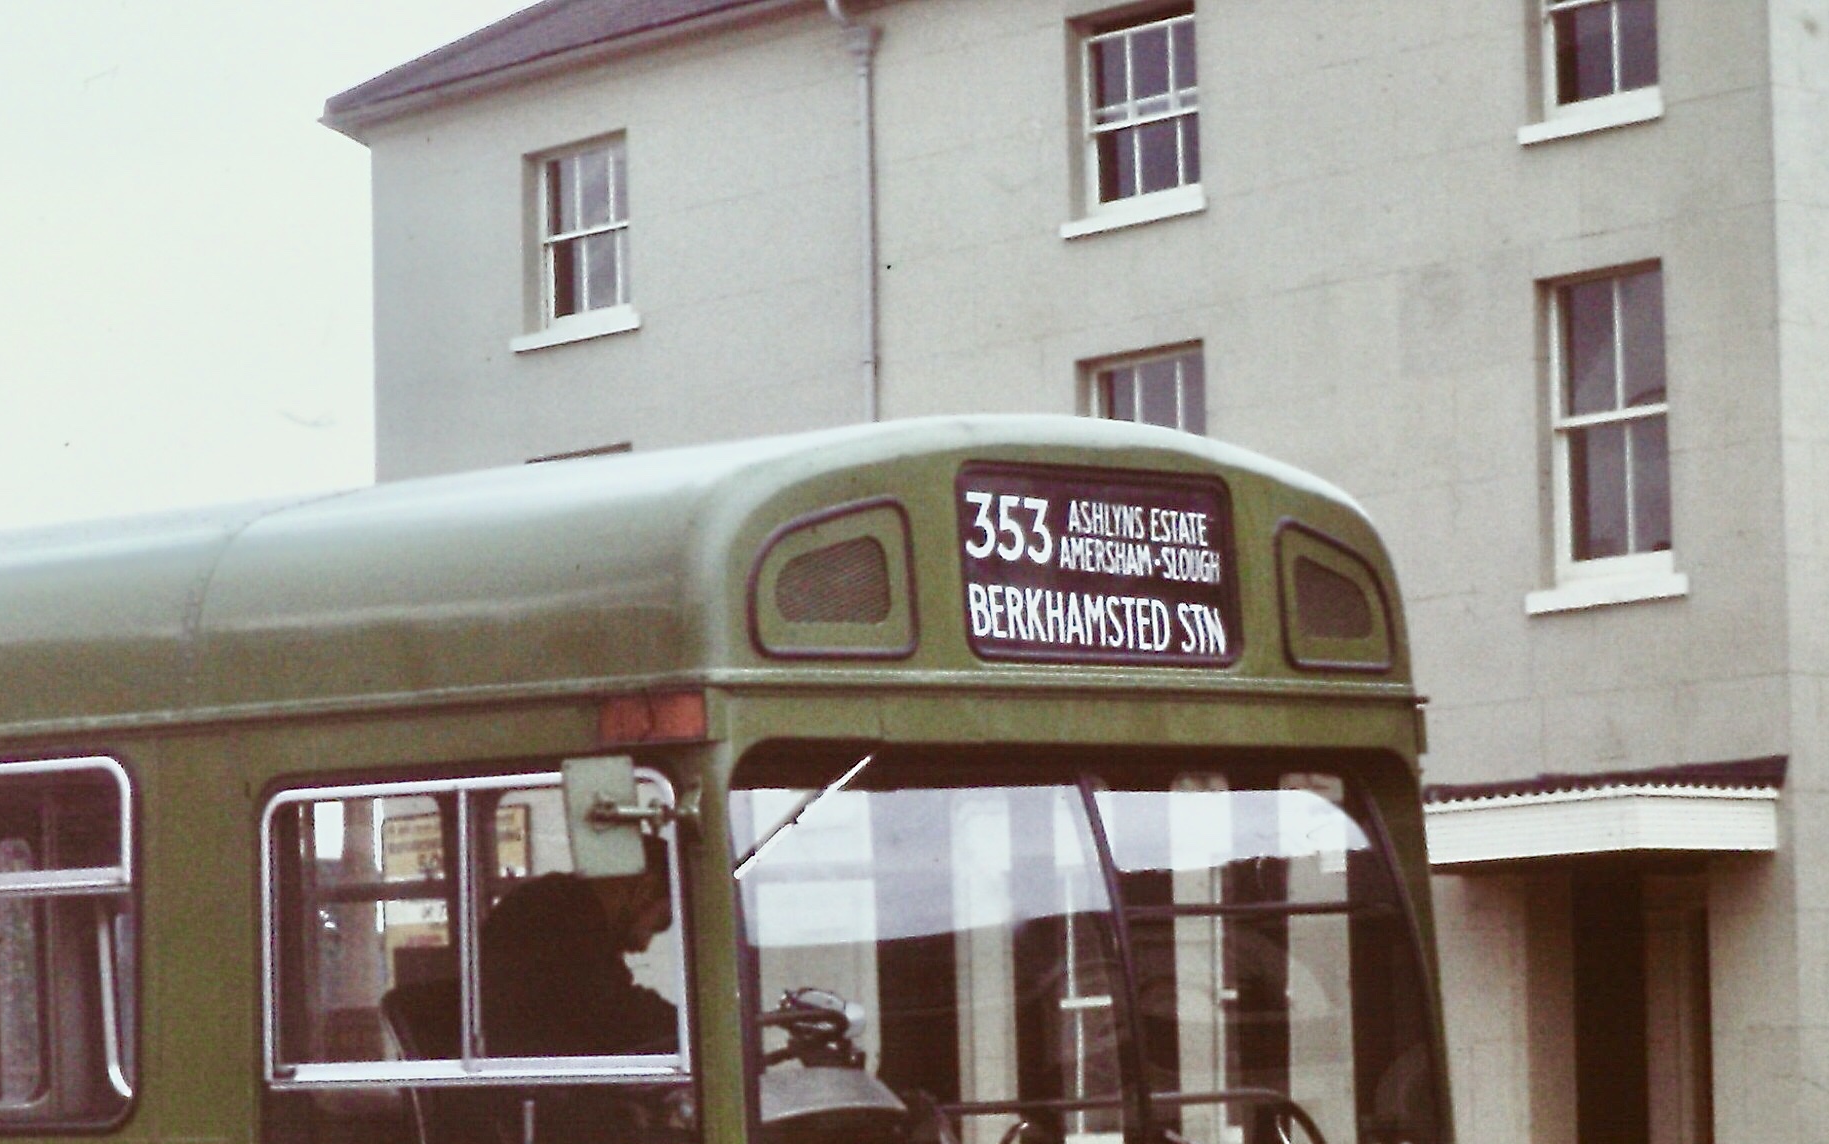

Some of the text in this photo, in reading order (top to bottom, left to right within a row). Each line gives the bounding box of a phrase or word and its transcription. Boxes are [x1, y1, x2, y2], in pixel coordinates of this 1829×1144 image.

[965, 491, 1052, 563] 353
[1068, 500, 1208, 547] ASHLYNS ESTATE
[968, 583, 1226, 655] BERKHAMSTED STN
